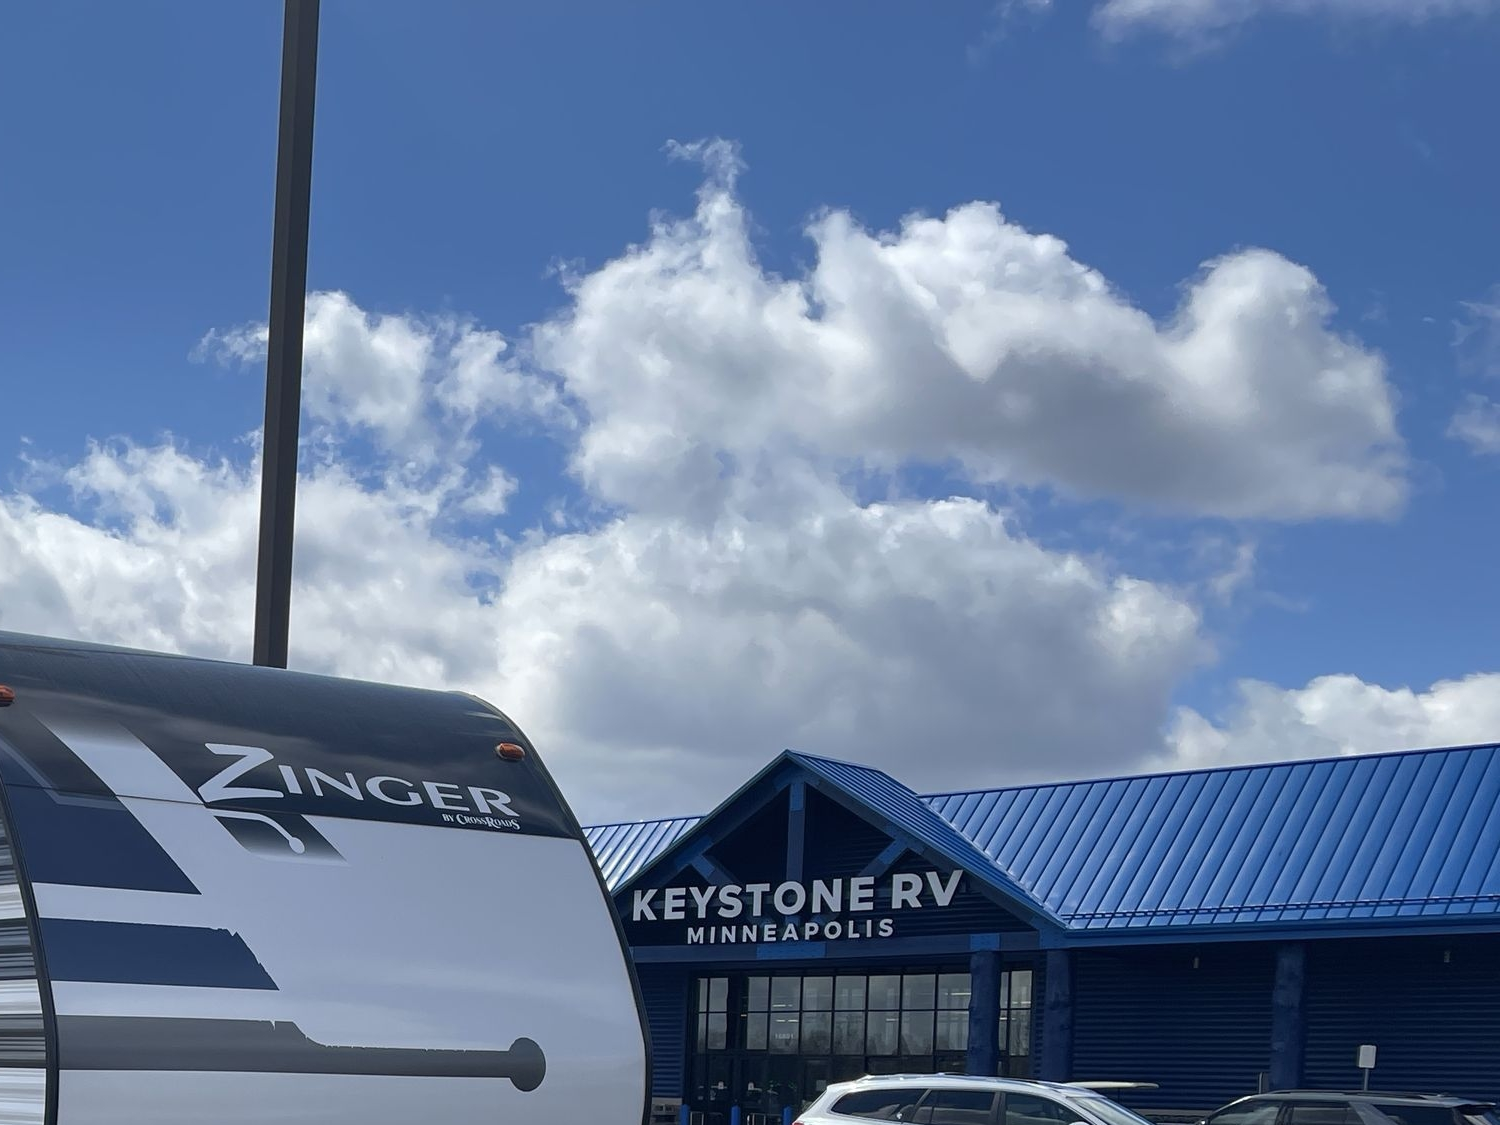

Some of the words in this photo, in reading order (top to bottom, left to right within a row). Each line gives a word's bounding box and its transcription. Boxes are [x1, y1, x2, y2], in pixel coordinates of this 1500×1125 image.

[197, 742, 521, 817] ZINGER
[441, 813, 455, 823] BY
[631, 875, 875, 922] KEYSTONE
[891, 869, 964, 910] RV
[687, 917, 895, 945] MINNEAPOLIS
